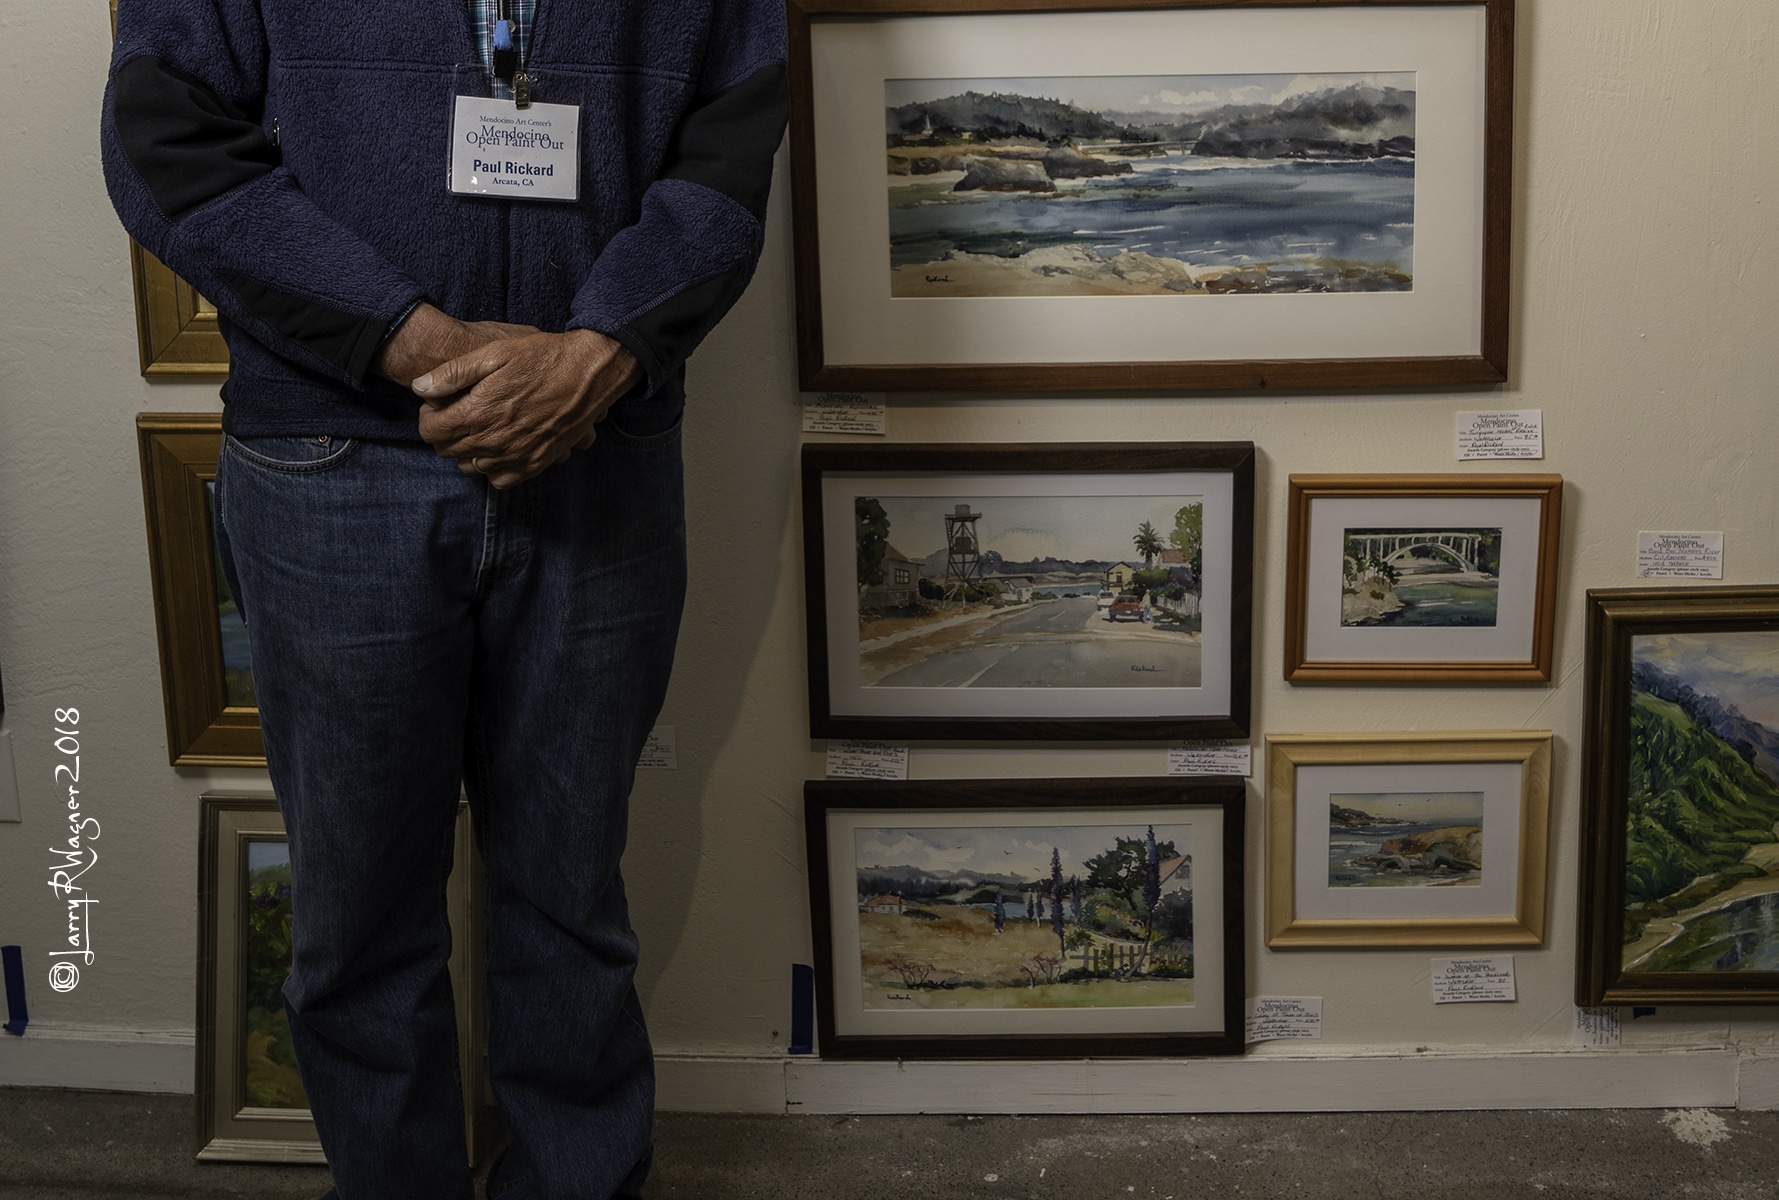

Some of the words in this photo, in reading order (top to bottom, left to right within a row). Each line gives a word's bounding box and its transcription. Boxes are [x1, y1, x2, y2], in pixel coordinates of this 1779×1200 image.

[480, 116, 514, 124] Mendocino
[466, 132, 500, 148] Open
[505, 134, 535, 148] Paint
[540, 138, 564, 150] Out
[482, 125, 549, 141] Mendocino
[474, 160, 500, 173] Paul
[505, 161, 553, 176] Rickard
[492, 178, 519, 186] Arcata,
